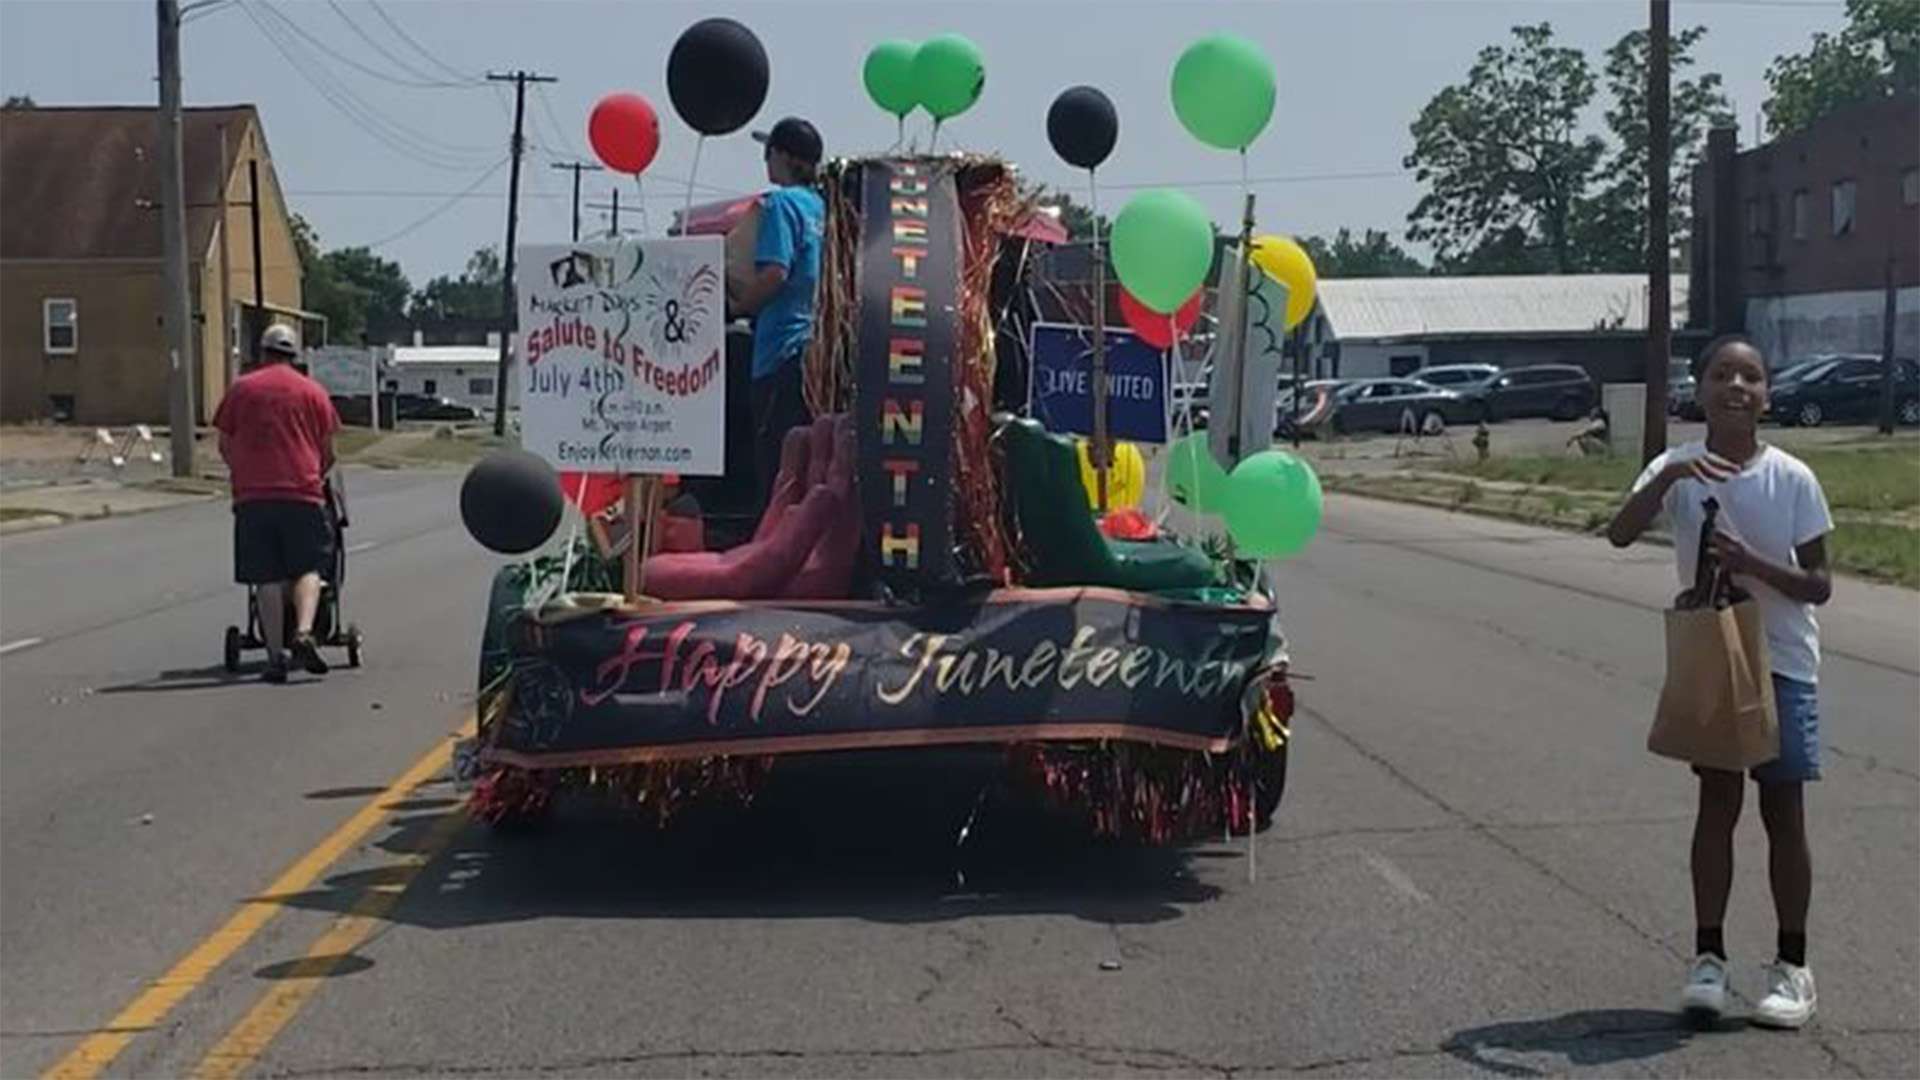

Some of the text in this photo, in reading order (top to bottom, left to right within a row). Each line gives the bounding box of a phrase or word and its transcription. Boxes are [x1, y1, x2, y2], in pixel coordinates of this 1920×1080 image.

[664, 300, 686, 343] &
[527, 316, 597, 366] Salute
[633, 346, 720, 397] Freedom
[528, 366, 571, 398] July
[1049, 370, 1155, 400] LIVE NITED
[580, 621, 852, 726] Happy
